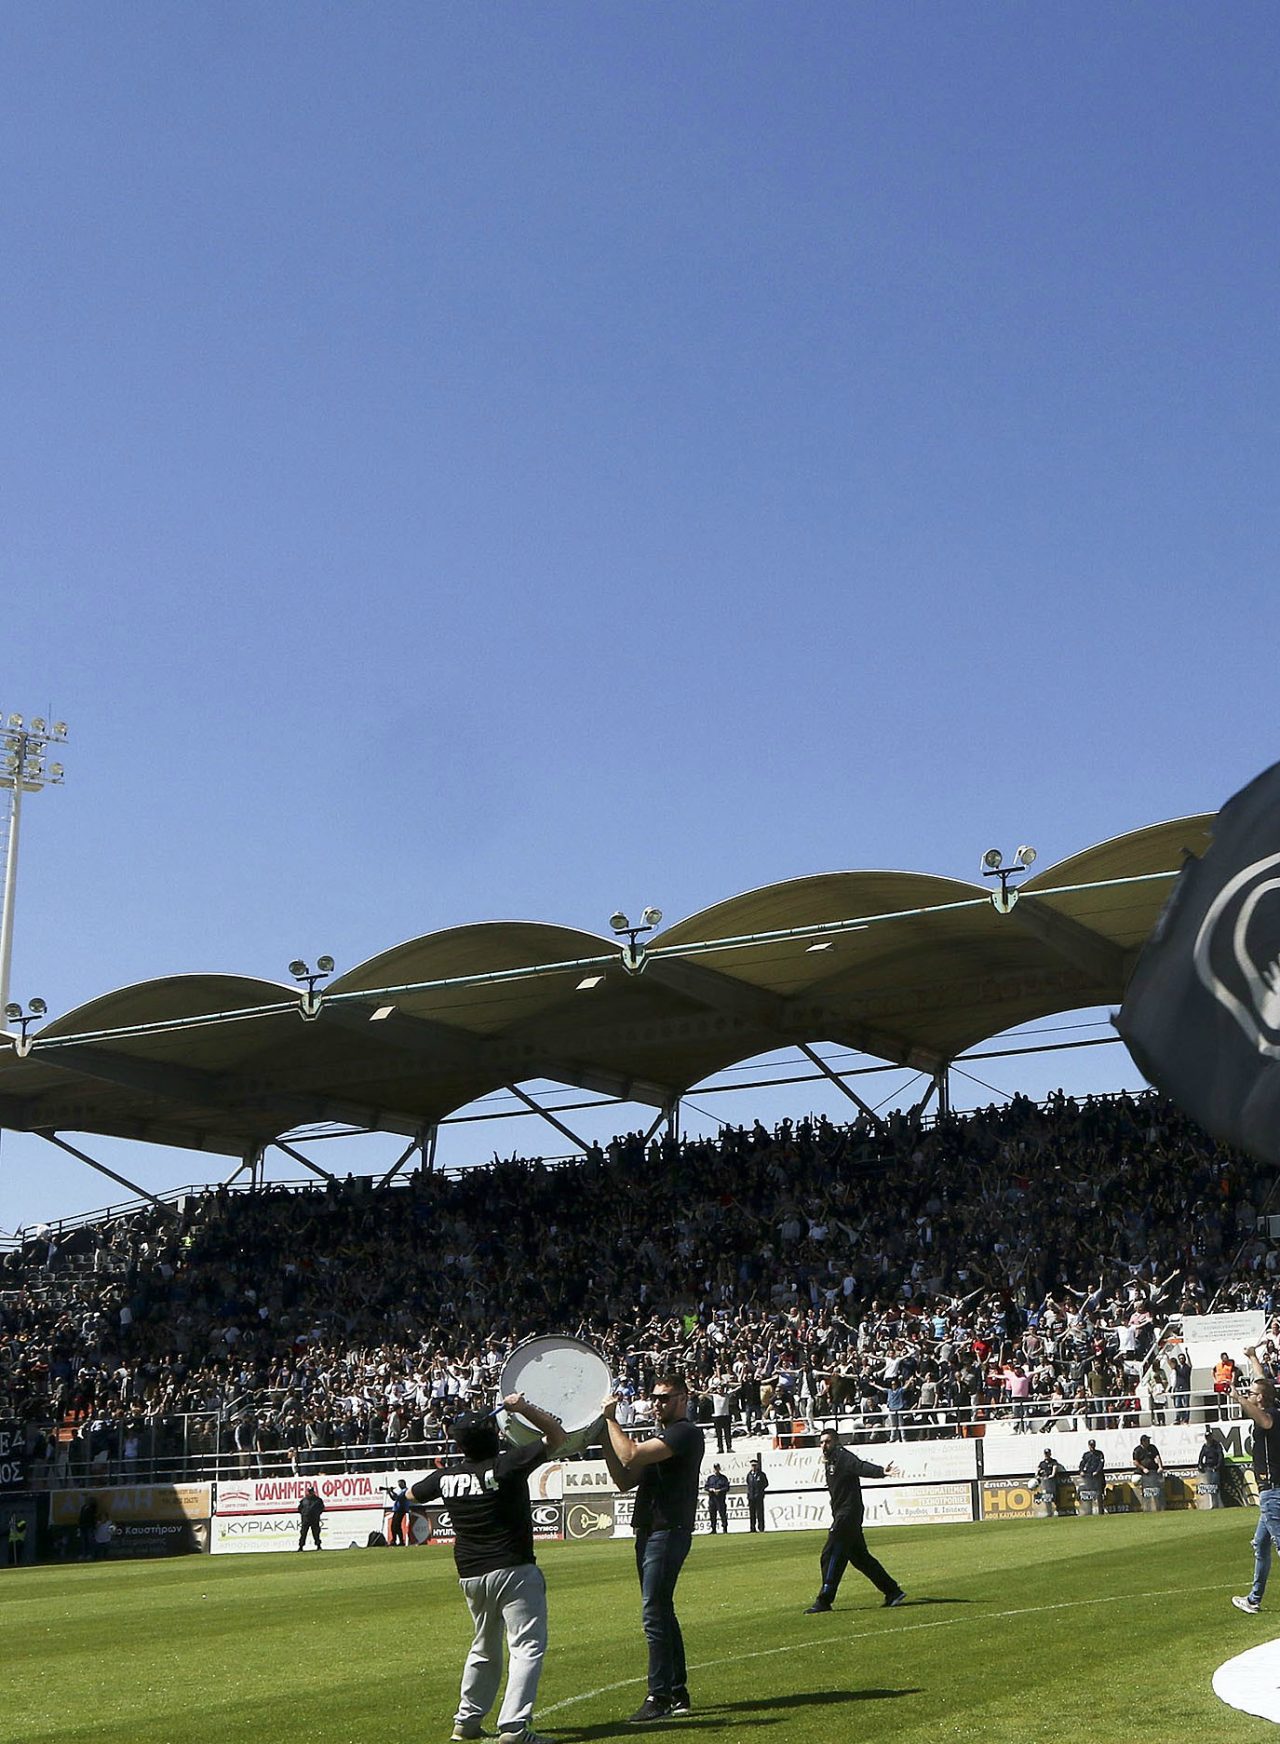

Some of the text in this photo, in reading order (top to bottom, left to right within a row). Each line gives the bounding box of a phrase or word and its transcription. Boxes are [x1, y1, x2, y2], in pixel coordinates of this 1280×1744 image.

[322, 1477, 372, 1498] ΦΡΟΥΤΑ
[566, 1473, 608, 1487] KAN
[227, 1518, 328, 1534] ΚΥΡΙΑΚΑΚΣ
[433, 1528, 456, 1536] HYUN
